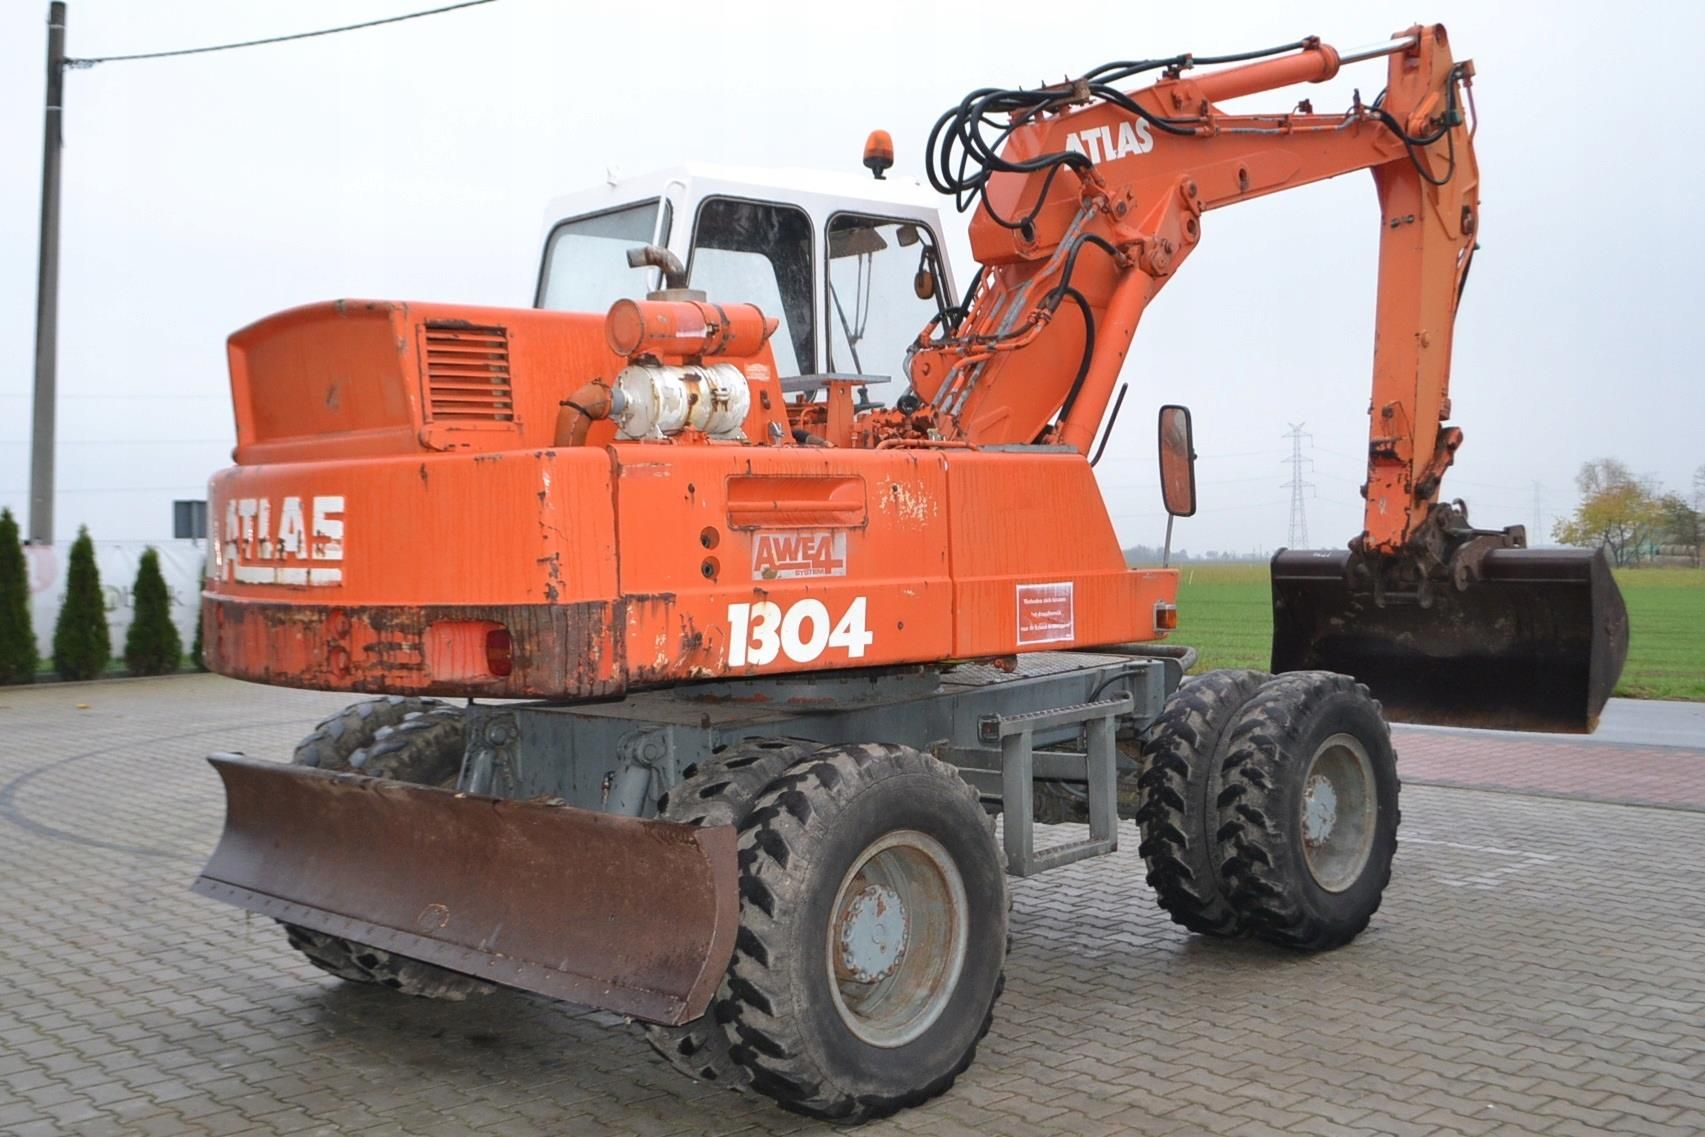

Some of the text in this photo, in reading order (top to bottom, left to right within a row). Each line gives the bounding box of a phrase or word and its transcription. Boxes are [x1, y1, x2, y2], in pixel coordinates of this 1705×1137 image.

[1064, 117, 1154, 172] ATLAS
[222, 496, 344, 585] ATLAS
[754, 535, 844, 574] AWE4
[728, 596, 873, 667] 1304
